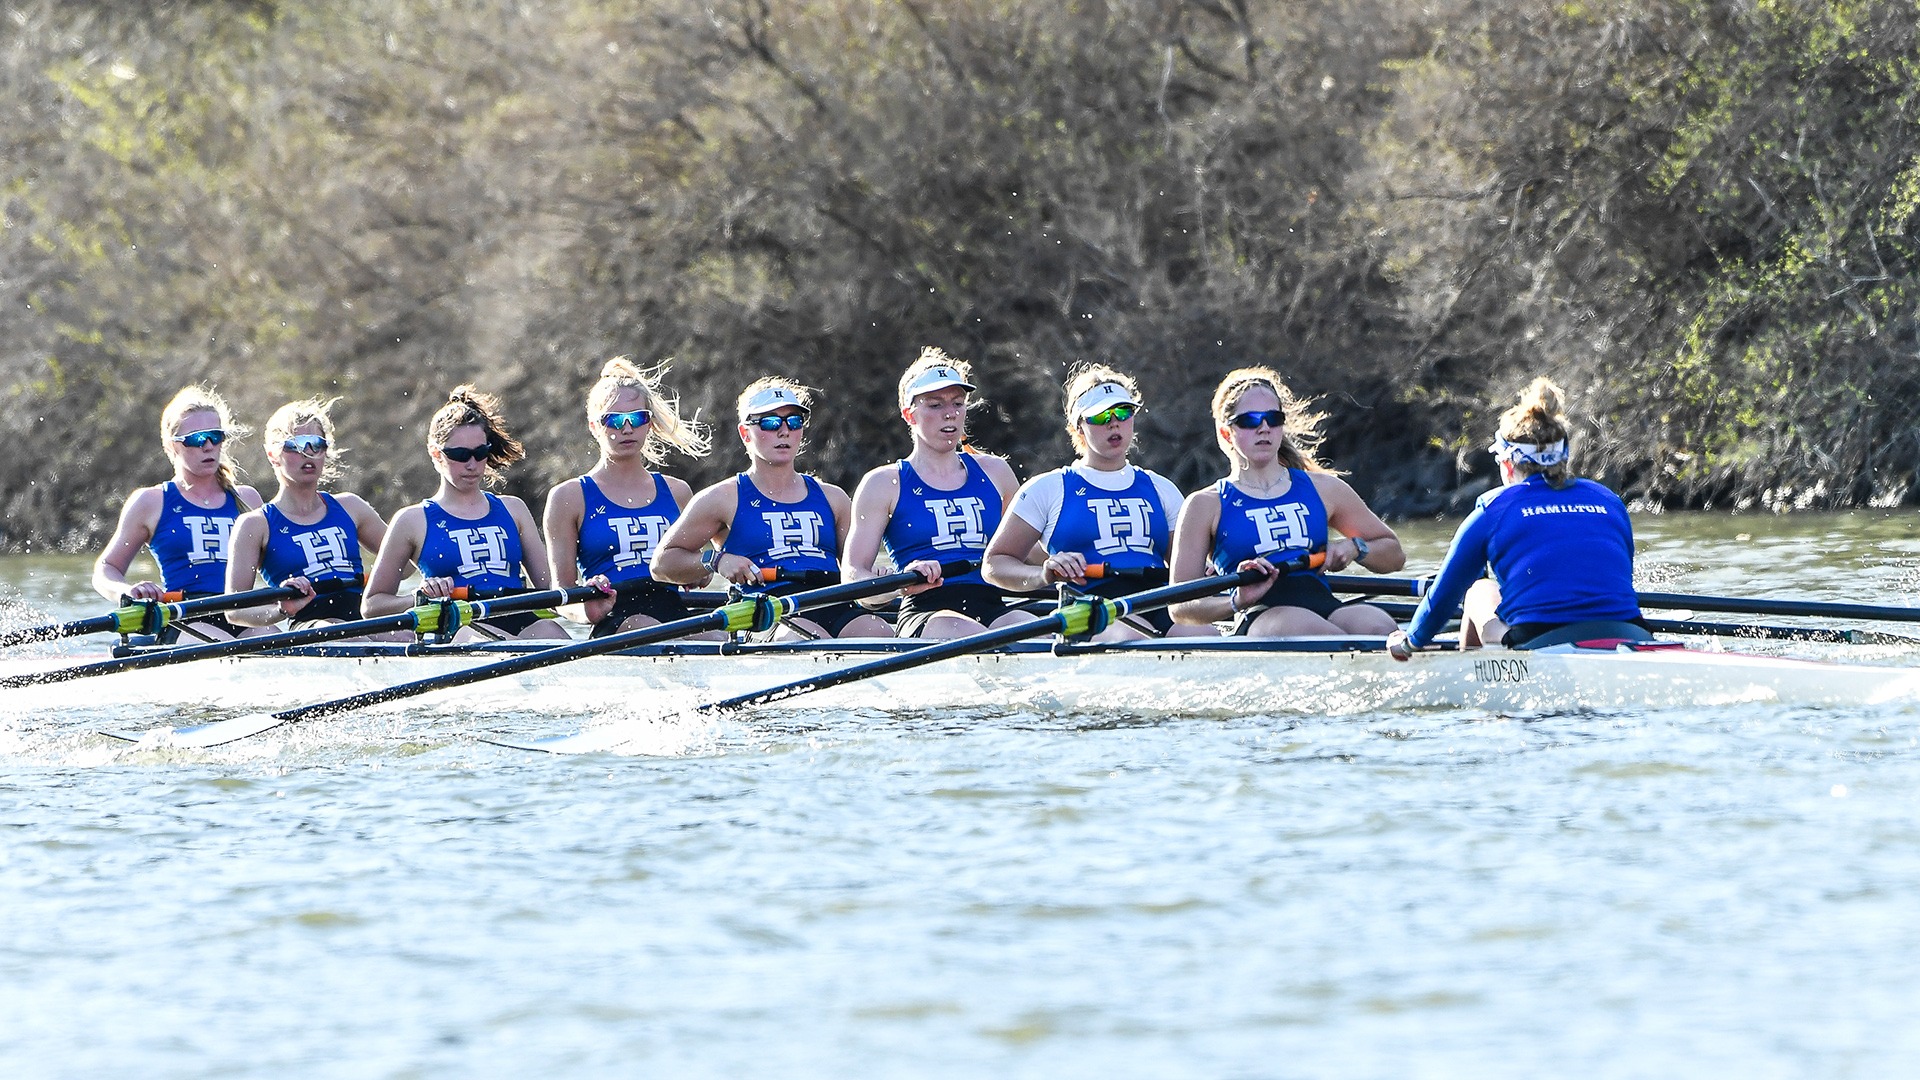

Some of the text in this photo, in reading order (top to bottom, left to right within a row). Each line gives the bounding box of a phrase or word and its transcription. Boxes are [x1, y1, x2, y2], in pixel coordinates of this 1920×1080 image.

[774, 390, 785, 399] H
[937, 369, 948, 378] H
[1103, 385, 1114, 394] H
[762, 511, 827, 560] H
[925, 496, 988, 550] H
[1087, 498, 1154, 556] H
[1246, 502, 1313, 557] H
[1520, 503, 1608, 518] HAMILTON
[183, 516, 233, 566] H
[292, 526, 355, 578] H
[449, 525, 511, 579] H
[608, 516, 672, 568] H
[1473, 658, 1530, 683] HUDSON
